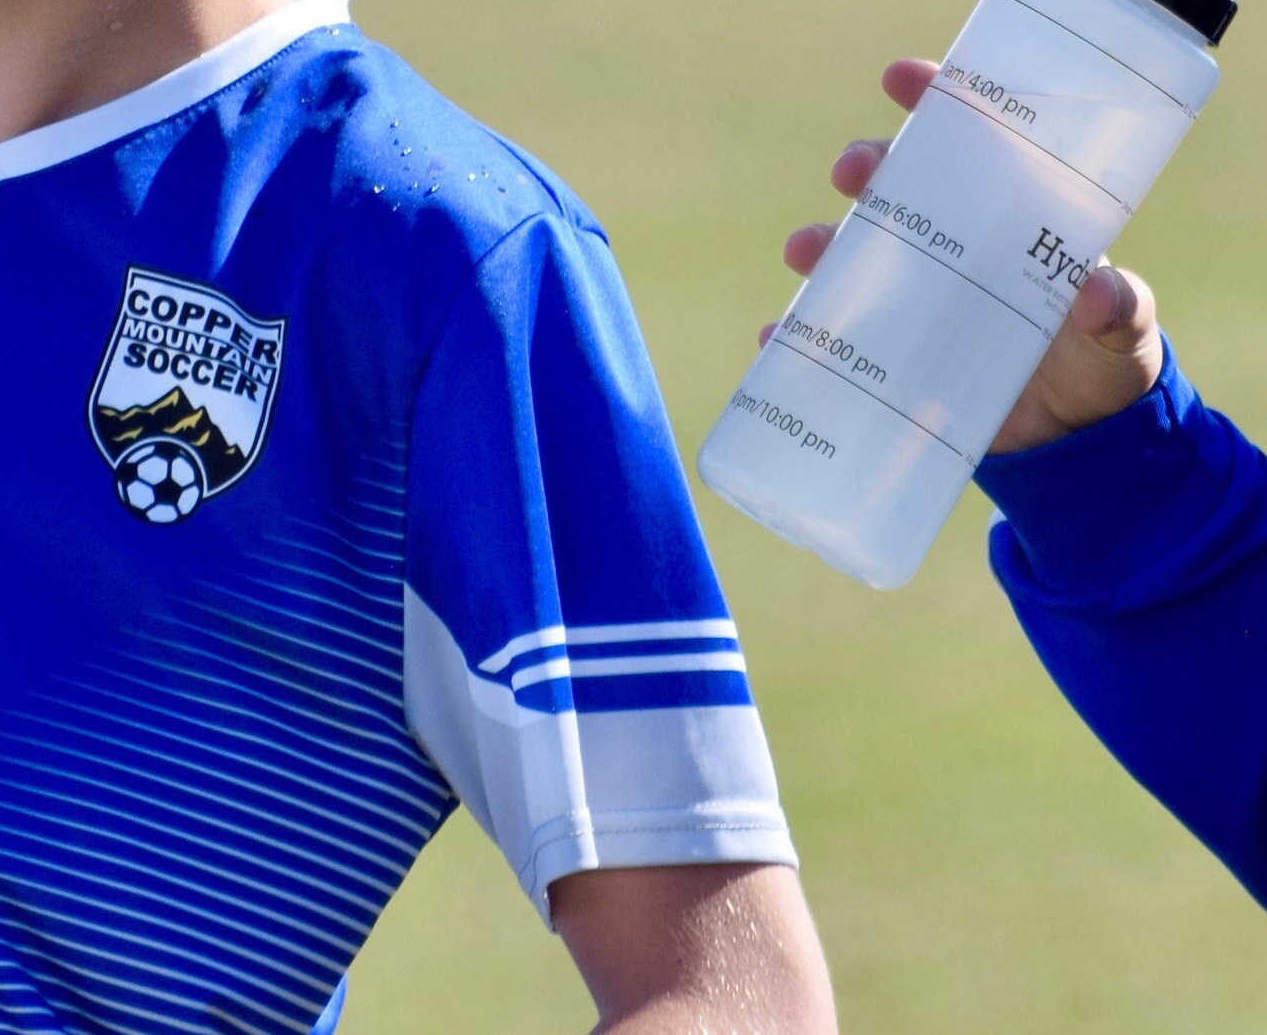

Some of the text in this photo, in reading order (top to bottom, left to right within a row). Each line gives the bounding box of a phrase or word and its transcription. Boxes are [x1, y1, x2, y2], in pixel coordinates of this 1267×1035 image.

[1001, 97, 1037, 125] pm
[928, 230, 964, 259] pm
[126, 288, 279, 366] COPPER
[121, 317, 273, 386] MOUNTAIN
[122, 341, 258, 403] SOCCER
[851, 356, 887, 384] pm
[800, 431, 836, 460] pm
